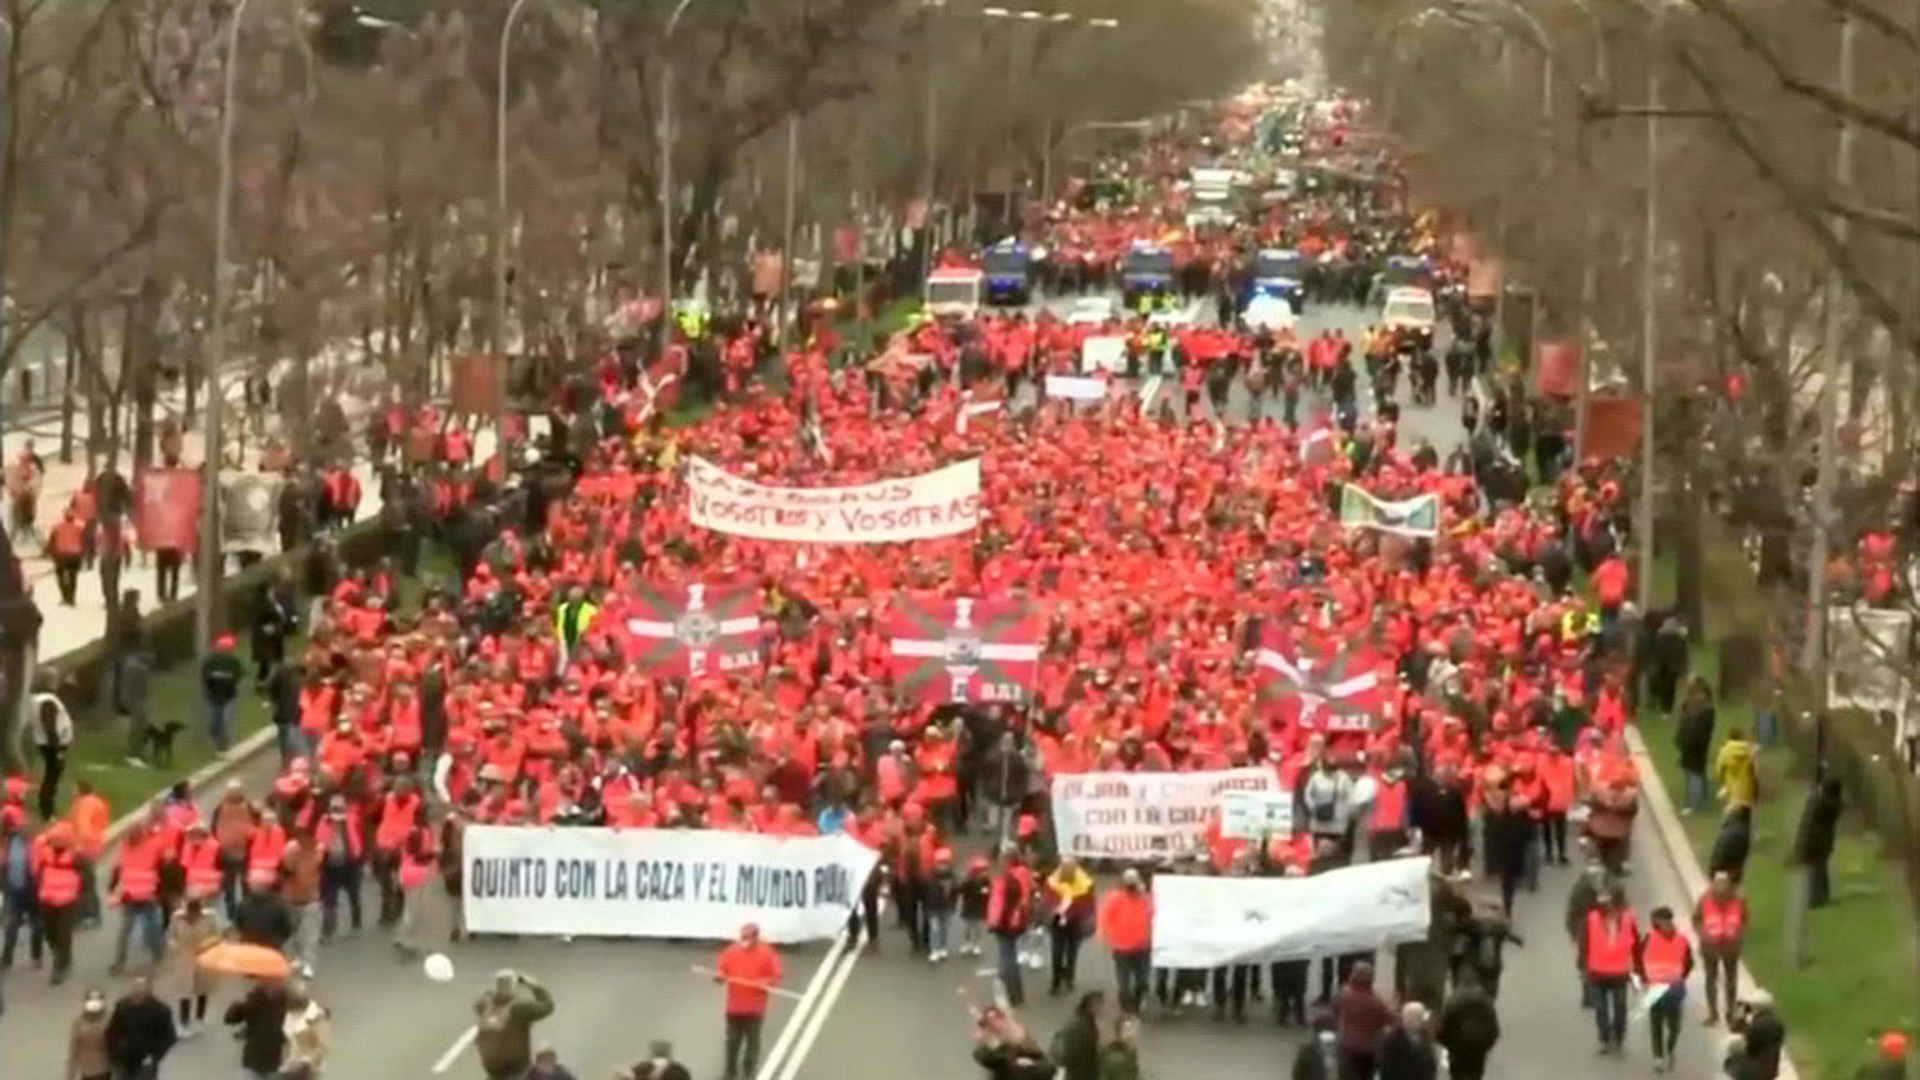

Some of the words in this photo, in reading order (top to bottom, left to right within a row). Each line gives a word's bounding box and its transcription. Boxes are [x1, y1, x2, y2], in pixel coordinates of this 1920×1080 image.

[555, 858, 596, 899] CON
[604, 861, 628, 900] LA
[636, 861, 685, 901] CAZA
[694, 863, 706, 896] Y
[709, 864, 727, 902] EL
[735, 865, 807, 908] MUNDO
